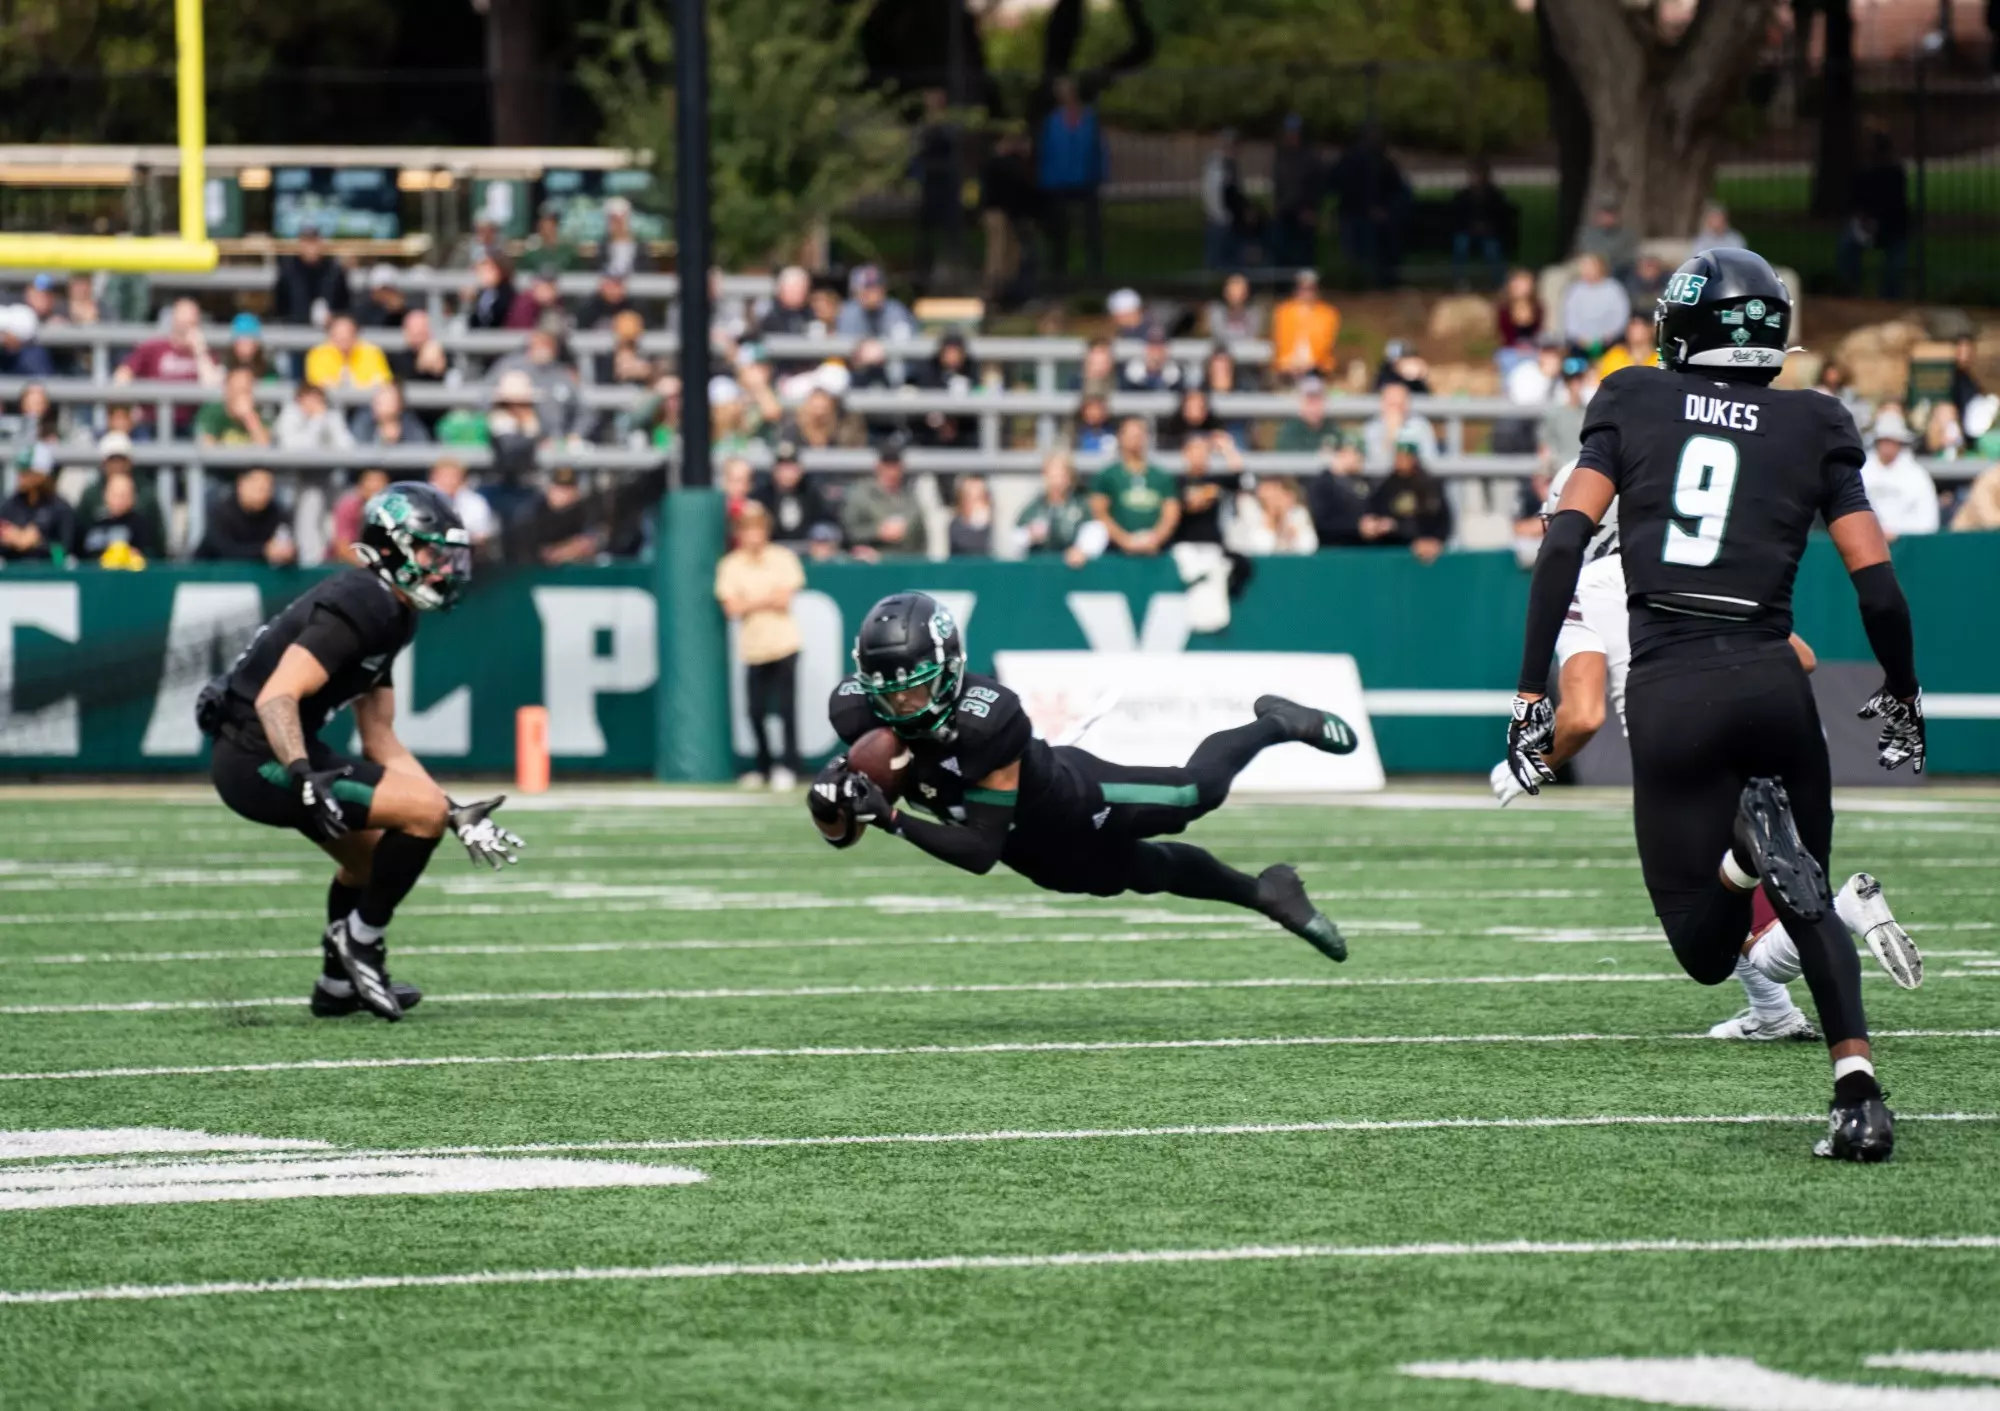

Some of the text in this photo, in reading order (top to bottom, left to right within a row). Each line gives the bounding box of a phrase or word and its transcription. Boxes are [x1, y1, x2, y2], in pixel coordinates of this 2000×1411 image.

[1684, 393, 1760, 431] DUKES
[1662, 433, 1740, 567] 9
[958, 686, 1000, 718] 32
